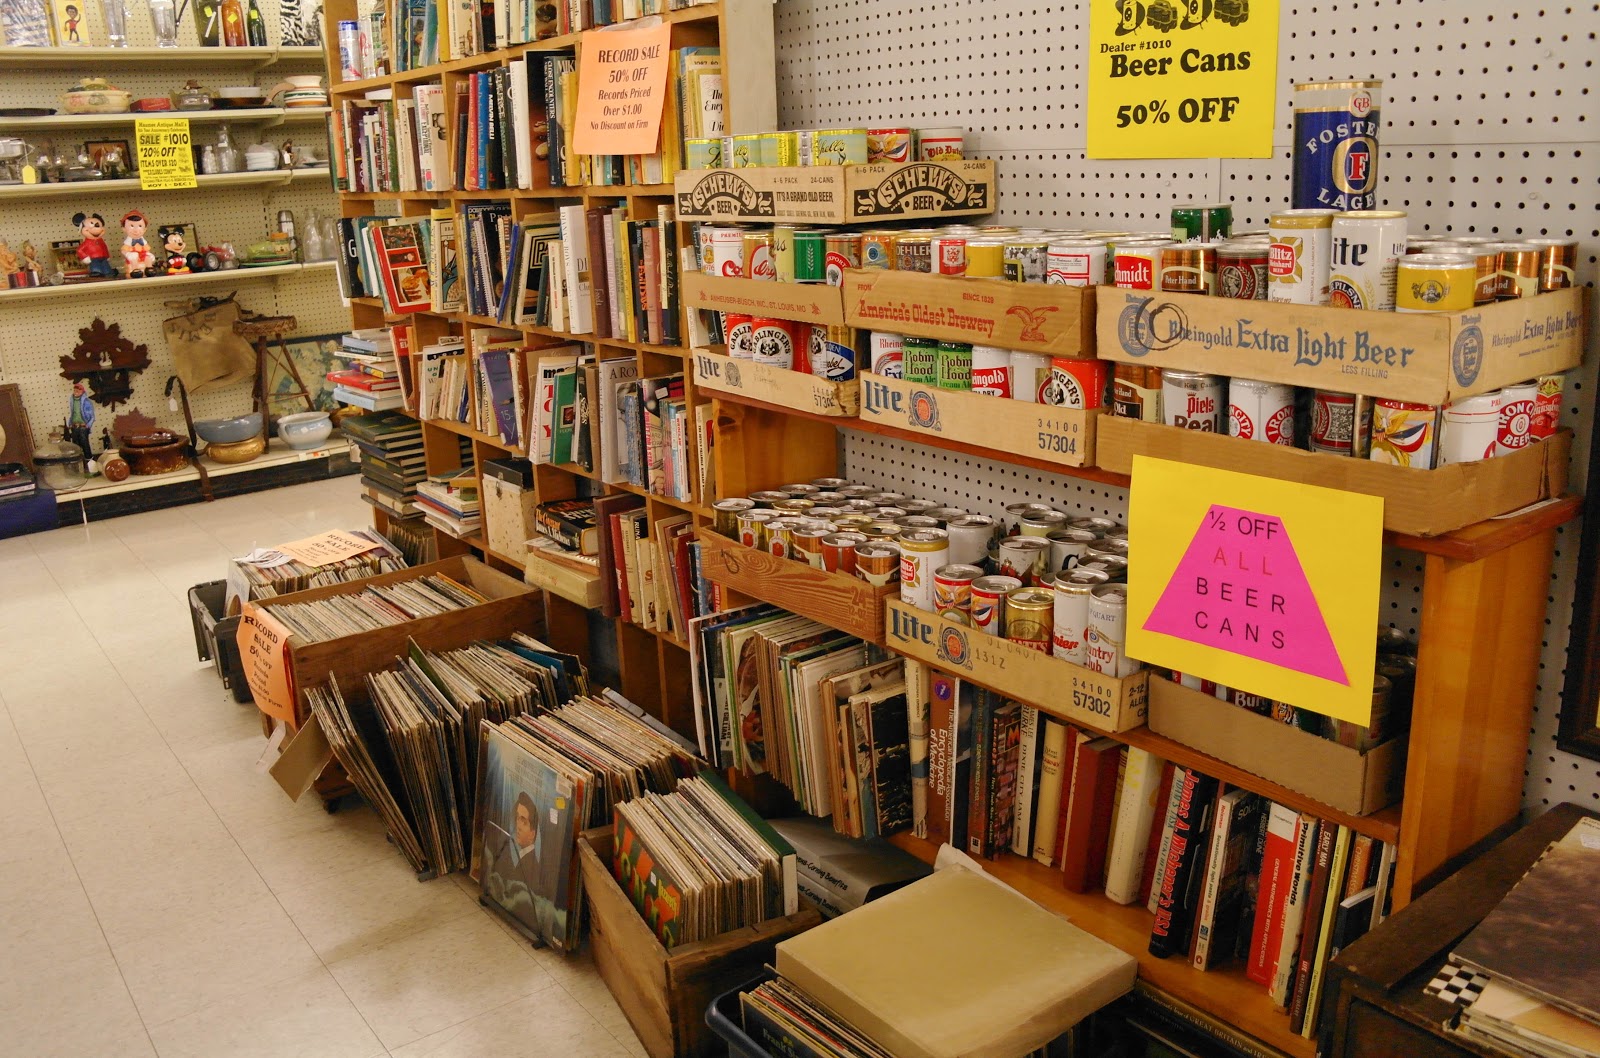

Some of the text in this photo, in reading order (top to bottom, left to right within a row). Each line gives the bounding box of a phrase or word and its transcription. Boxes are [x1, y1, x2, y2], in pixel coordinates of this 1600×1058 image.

[598, 44, 661, 63] RECORD SALE
[1100, 40, 1172, 54] Dealer #1010
[1110, 48, 1251, 78] Beer Cans
[609, 67, 649, 84] 50% OFF
[598, 86, 652, 101] Records Priced
[603, 103, 643, 117] Over $1.00
[1116, 96, 1240, 128] 50% OFF
[590, 120, 649, 130] No Discount on Firm
[140, 133, 189, 145] SALE #1010
[161, 146, 177, 157] OFF
[927, 148, 944, 158] Old
[155, 159, 168, 167] OVER
[869, 165, 885, 173] PACK
[963, 162, 987, 170] 24-CANS
[810, 176, 834, 184] 24-CANS
[880, 166, 965, 204] SCHELL'S
[694, 174, 756, 207] SCHELL'S
[818, 191, 834, 203] BEER
[716, 200, 733, 215] BEER
[912, 195, 934, 211] BEER
[858, 284, 873, 292] FROM
[1179, 275, 1197, 285] Hand
[962, 292, 980, 302] SINCE
[859, 299, 995, 339] America's Oldest Brewery
[1523, 319, 1544, 340] Extra
[1544, 315, 1564, 341] Light
[1236, 318, 1290, 353] Extra
[1294, 327, 1347, 367] Light
[1352, 330, 1415, 369] Beer
[905, 350, 934, 363] Robin
[696, 354, 721, 380] Lite
[905, 362, 933, 375] Hood
[1341, 365, 1389, 379] LESS FILLING
[864, 380, 903, 415] Lite
[1187, 396, 1214, 418] Piels
[1498, 401, 1525, 429] IRON
[1038, 418, 1078, 433] 34100
[1038, 432, 1077, 455] 57304
[1237, 516, 1279, 540] OFF
[325, 540, 351, 552] SALE
[327, 534, 365, 550] RECORD
[1213, 547, 1273, 576] ALL
[1196, 577, 1286, 615] BEER
[244, 615, 278, 644] RECORD
[890, 607, 934, 645] Lite
[1195, 611, 1285, 649] CANS
[254, 633, 272, 655] SALE
[1072, 678, 1112, 698] 34100
[268, 698, 283, 709] Firm
[1073, 690, 1112, 718] 57302
[928, 729, 937, 788] of Medicine
[936, 728, 948, 796] Encyclopedia
[1321, 831, 1332, 853] EARLY
[1152, 769, 1199, 936] James A. Michener's USA
[1318, 852, 1328, 868] MAN
[1272, 858, 1280, 881] GENERAL
[1289, 822, 1309, 906] Primitive Worlds
[825, 872, 848, 891] Benefits
[1266, 881, 1278, 918] MATHEMATICS
[1258, 930, 1269, 968] APPLICATIONS
[1301, 960, 1309, 973] LIFE
[1190, 1016, 1212, 1032] GREAT
[1214, 1028, 1243, 1048] BRITAIN
